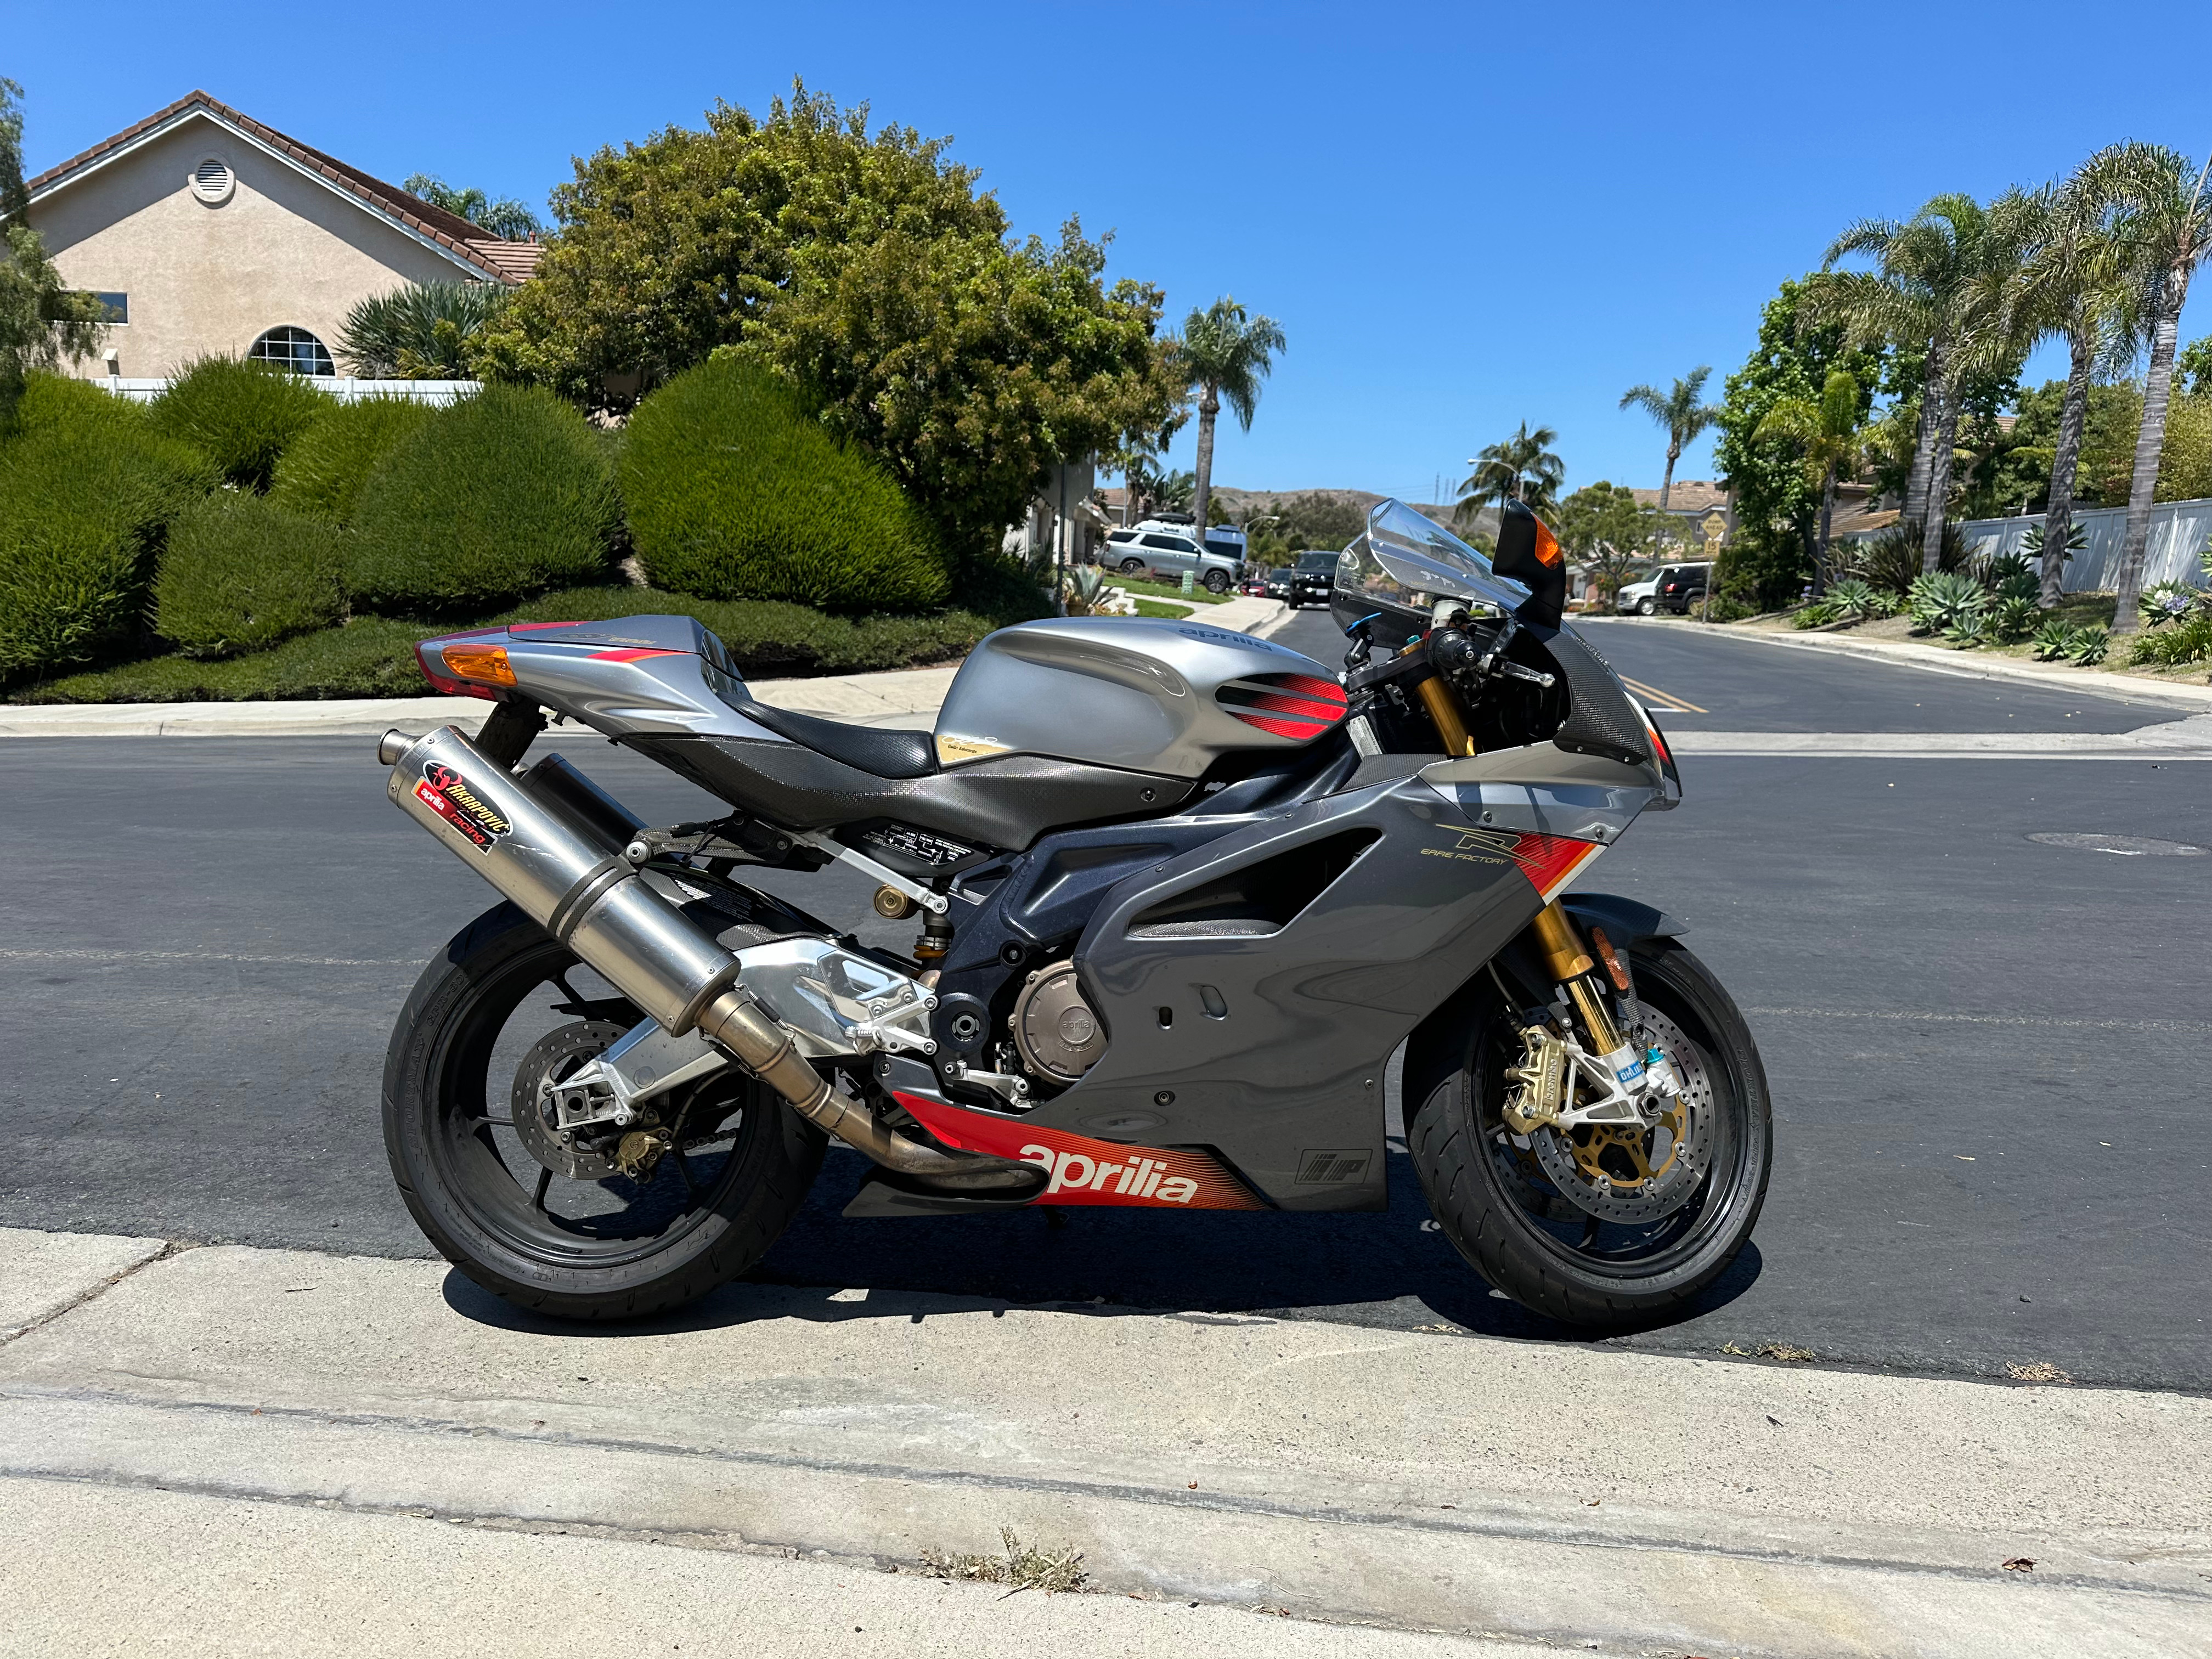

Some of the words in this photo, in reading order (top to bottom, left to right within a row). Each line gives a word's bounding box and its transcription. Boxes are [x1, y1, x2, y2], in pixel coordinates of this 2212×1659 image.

[1179, 628, 1272, 651] aprilia
[421, 788, 445, 811] aprilia
[449, 812, 486, 844] racing
[1455, 854, 1508, 865] FACTORY
[1063, 1019, 1090, 1029] aprilia
[1019, 1144, 1198, 1203] aprilia
